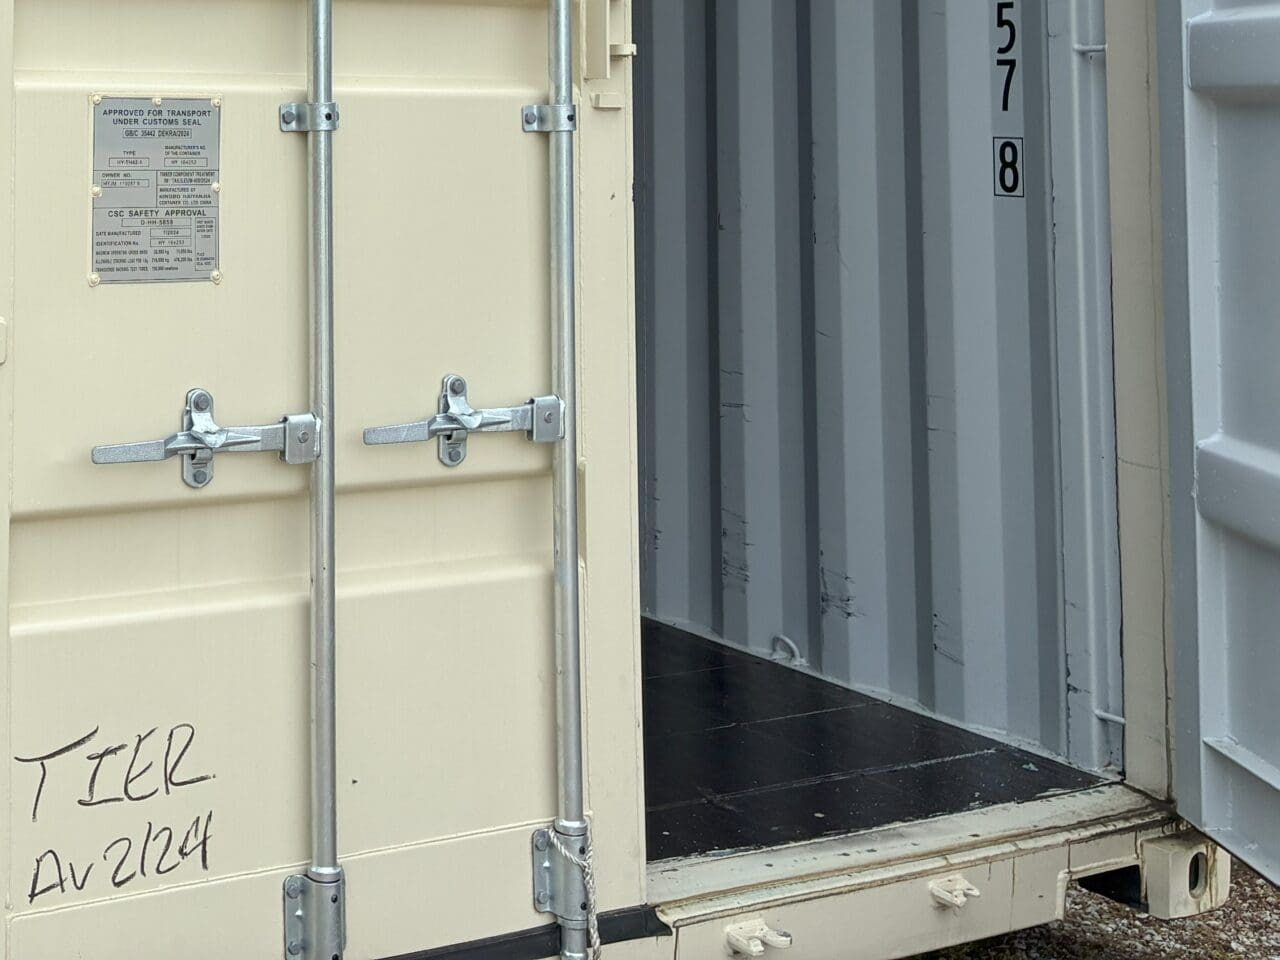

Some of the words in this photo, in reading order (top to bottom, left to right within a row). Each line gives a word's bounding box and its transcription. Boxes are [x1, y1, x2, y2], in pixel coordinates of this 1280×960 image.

[102, 109, 145, 117] APPROVED
[147, 109, 163, 117] FOR
[166, 109, 212, 117] TRANSPORT
[112, 118, 139, 126] UNDER
[142, 118, 179, 126] CUSTOMS
[998, 140, 1019, 194] 8
[107, 210, 125, 218] CSC
[128, 209, 160, 218] SAFETY
[164, 209, 207, 217] APPROVAL
[13, 722, 216, 823] TIER
